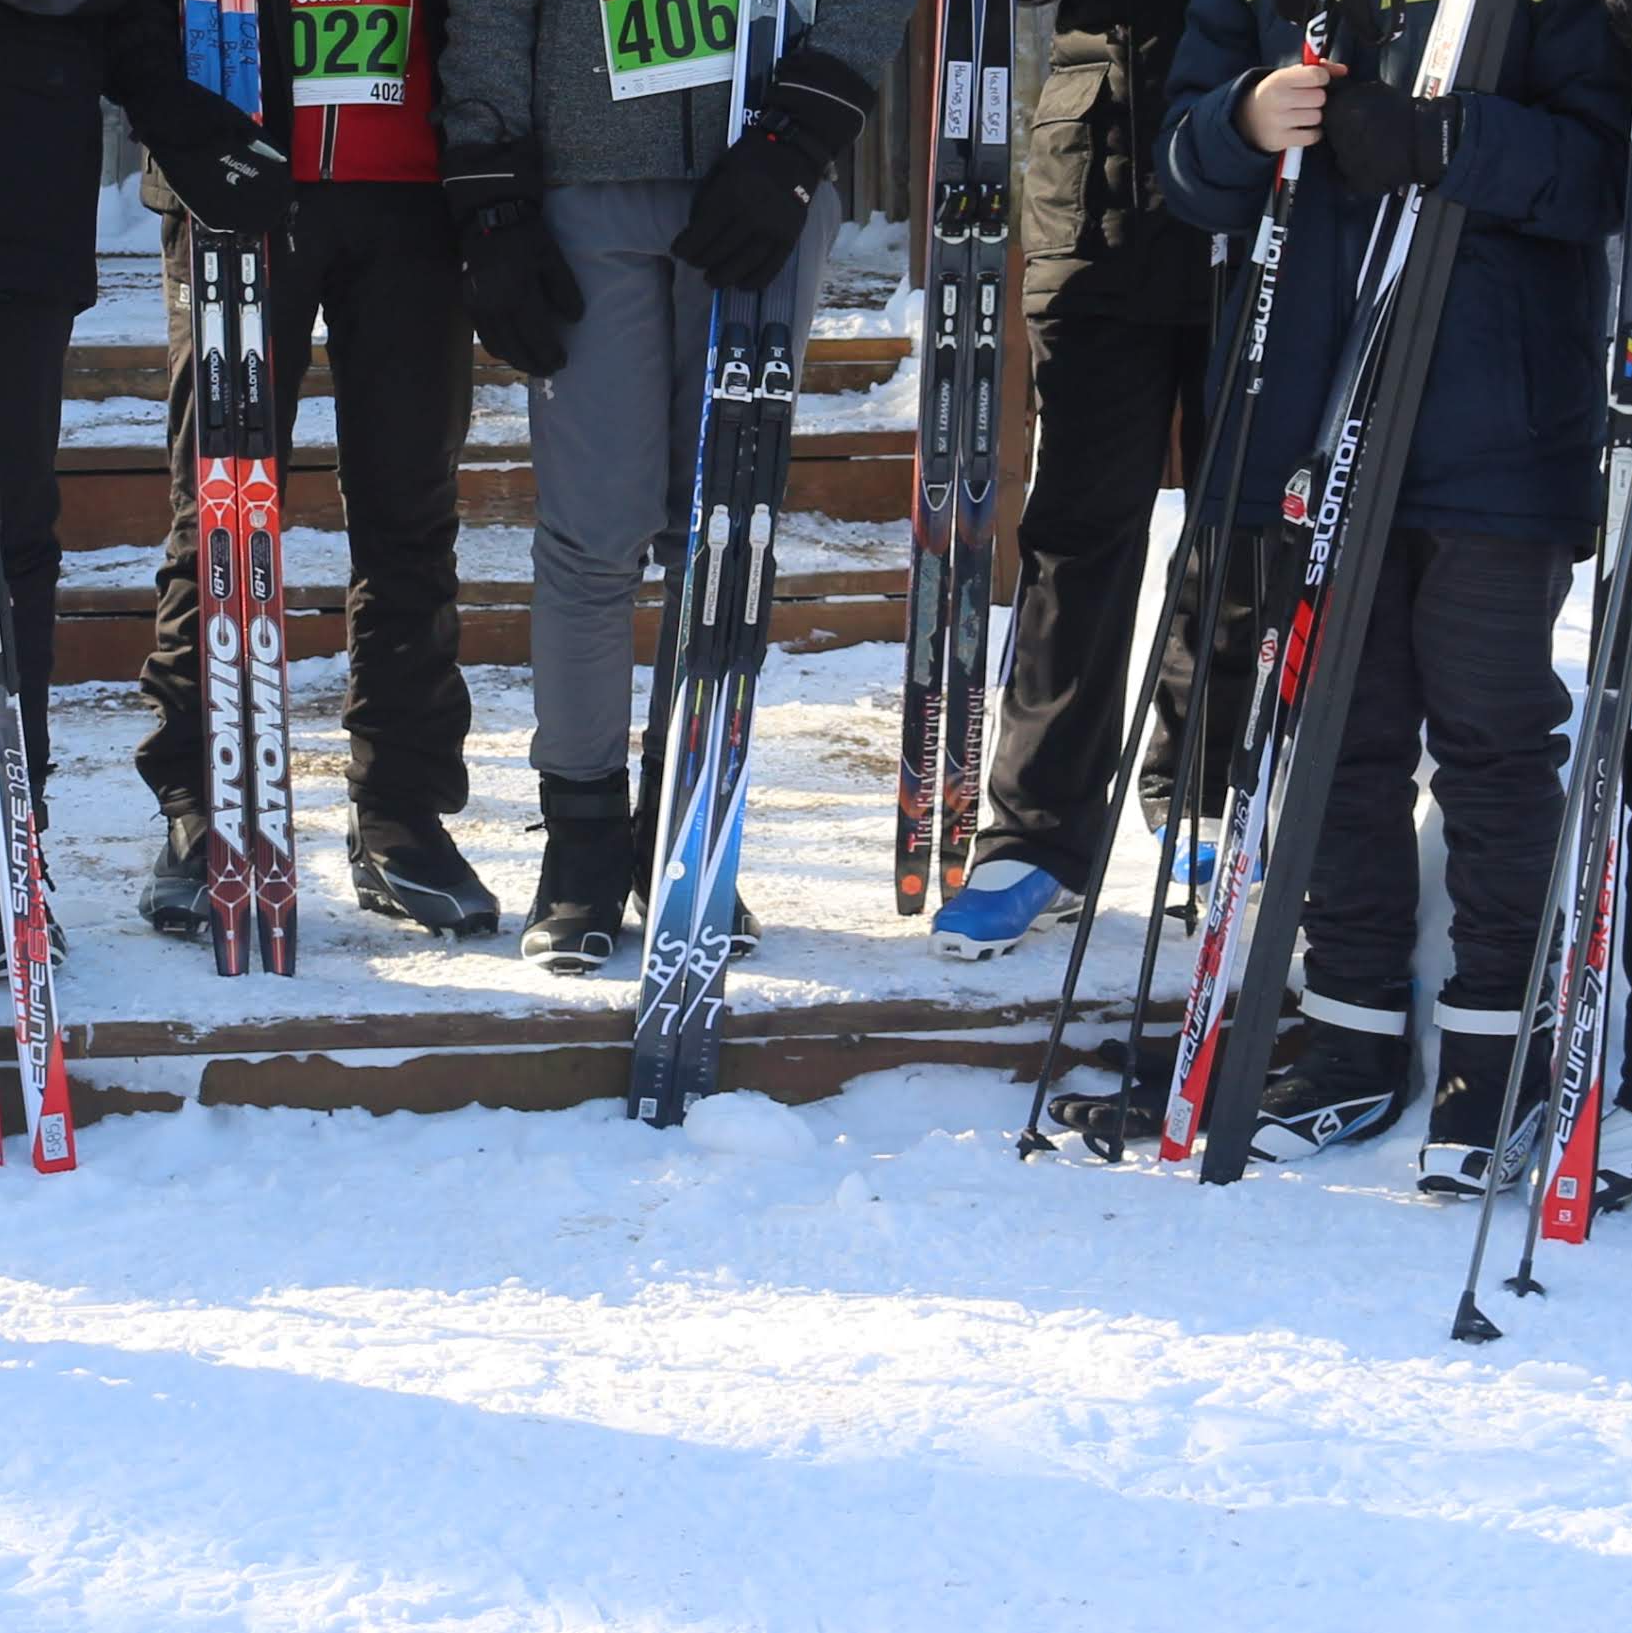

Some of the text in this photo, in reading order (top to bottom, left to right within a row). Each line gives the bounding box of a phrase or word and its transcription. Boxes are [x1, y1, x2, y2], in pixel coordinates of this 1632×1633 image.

[370, 81, 405, 102] 4022
[213, 564, 225, 597] 184
[254, 566, 266, 599] 184
[207, 614, 246, 858] ATOMIC
[254, 615, 292, 858] ATOMIC
[6, 748, 29, 916] SKATE 181
[646, 930, 689, 985] RS
[689, 925, 732, 982] RS
[658, 1004, 678, 1036] 7
[703, 998, 723, 1031] 7
[45, 1120, 64, 1158] 585
